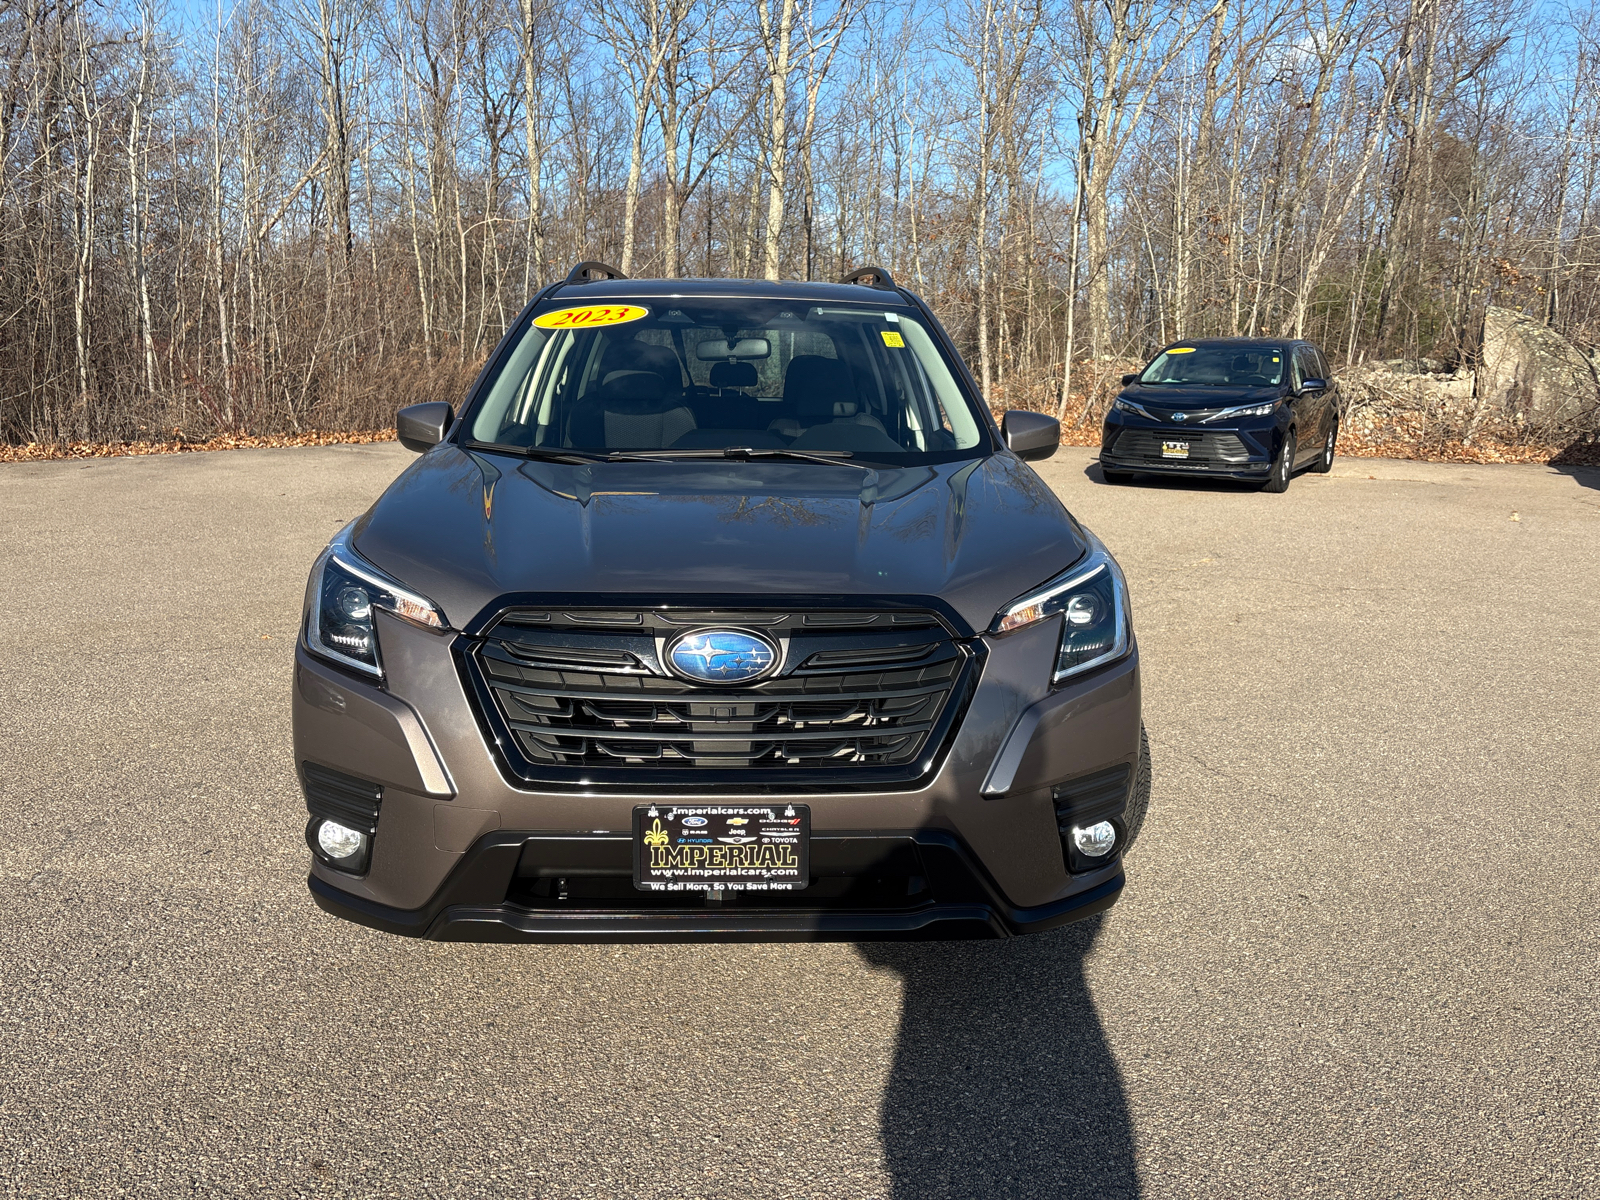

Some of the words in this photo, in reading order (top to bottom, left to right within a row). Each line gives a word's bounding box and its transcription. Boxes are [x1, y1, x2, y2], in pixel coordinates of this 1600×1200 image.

[551, 308, 630, 326] 2023
[672, 807, 771, 816] Imperialcars.com
[728, 828, 746, 836] Jeep
[650, 845, 798, 868] IMPERIAL
[650, 868, 798, 877] www.imperialcars.com
[650, 883, 665, 891] We
[667, 883, 683, 891] Sell
[686, 883, 711, 891] More,
[746, 882, 768, 890] Save
[770, 882, 792, 890] More
